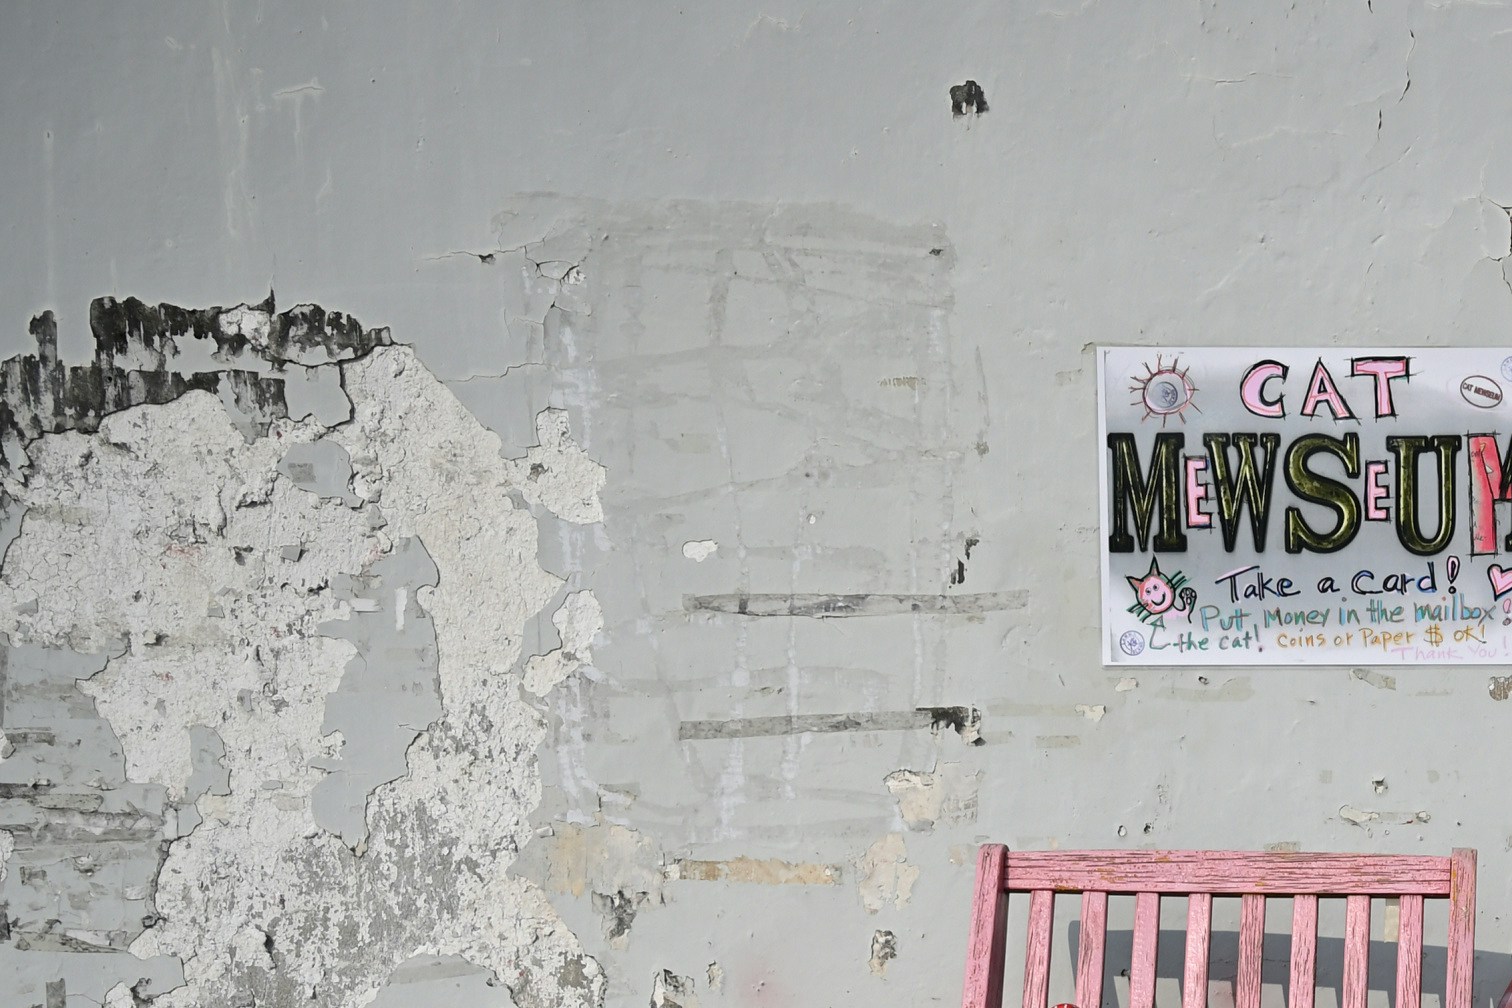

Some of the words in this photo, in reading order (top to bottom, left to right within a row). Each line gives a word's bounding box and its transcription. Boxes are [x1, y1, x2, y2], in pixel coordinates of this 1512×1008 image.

[1240, 357, 1413, 421] CAT
[1215, 565, 1301, 603] Take
[1317, 577, 1340, 593] a
[1200, 605, 1251, 632] Put
[1264, 608, 1330, 628] Money
[1339, 597, 1361, 626] in
[1366, 599, 1404, 624] the
[1173, 632, 1209, 653] the
[1219, 624, 1264, 652] cat!
[1334, 633, 1353, 646] or
[1359, 627, 1415, 652] Paper
[1424, 624, 1444, 647] $
[1391, 646, 1463, 661] Thank
